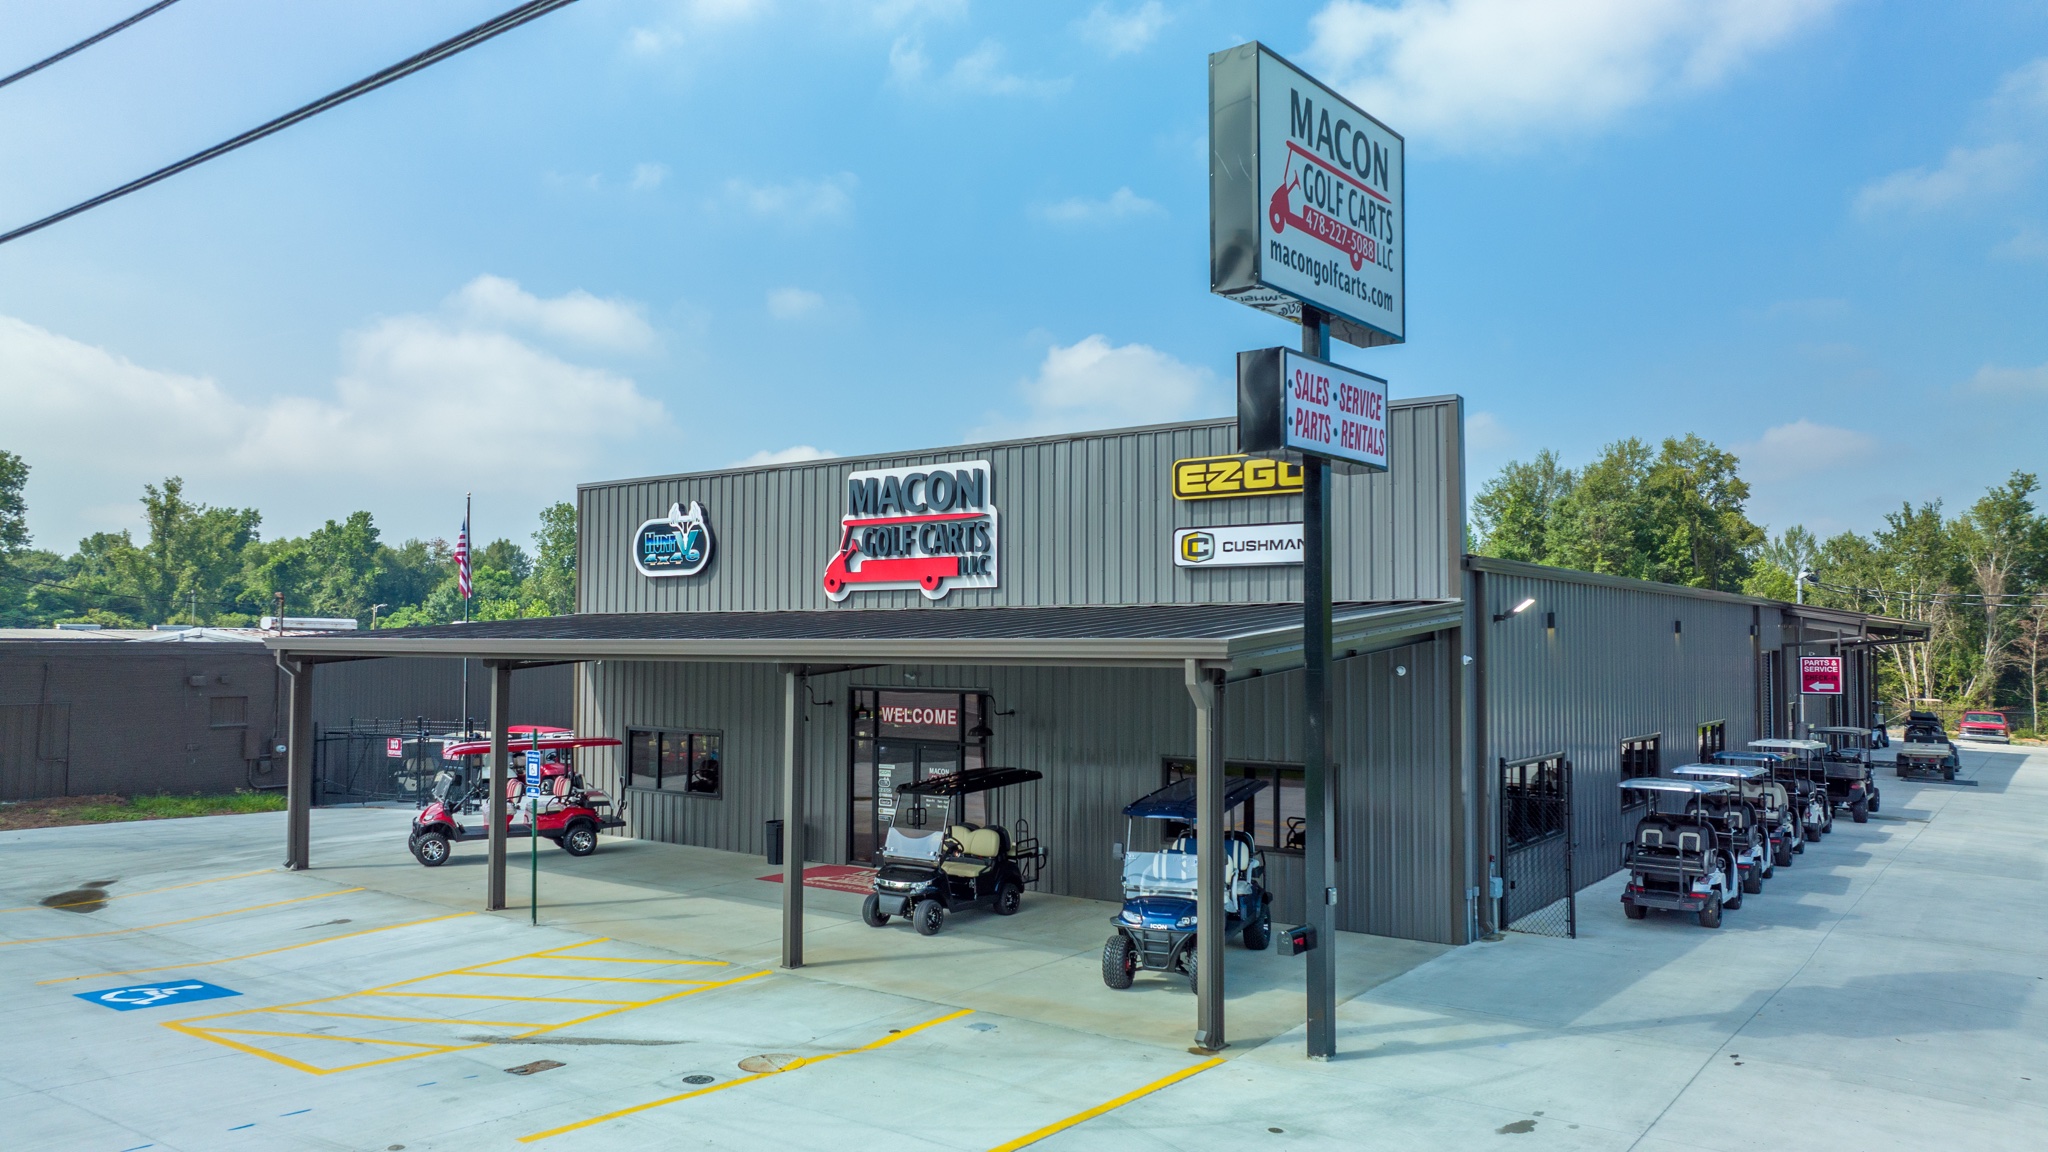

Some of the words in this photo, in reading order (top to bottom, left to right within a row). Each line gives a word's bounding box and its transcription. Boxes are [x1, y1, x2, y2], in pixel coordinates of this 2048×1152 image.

[1290, 87, 1389, 192] MACON
[1303, 163, 1344, 217] GOLF
[1348, 188, 1393, 245] CARTS
[1305, 210, 1375, 260] 478-227-5088
[1270, 239, 1393, 312] macongolfcarts.com
[1376, 248, 1393, 272] LLC
[1294, 369, 1330, 407] SALES
[1339, 383, 1382, 421] SERVICE
[1295, 407, 1331, 444] PARTS
[1340, 419, 1385, 457] RENTALS
[849, 468, 983, 516] MACON
[862, 525, 916, 558] GOLF
[919, 521, 990, 555] CARTS
[959, 555, 991, 576] LLC
[882, 707, 957, 725] WELCOME
[929, 767, 950, 775] MACON
